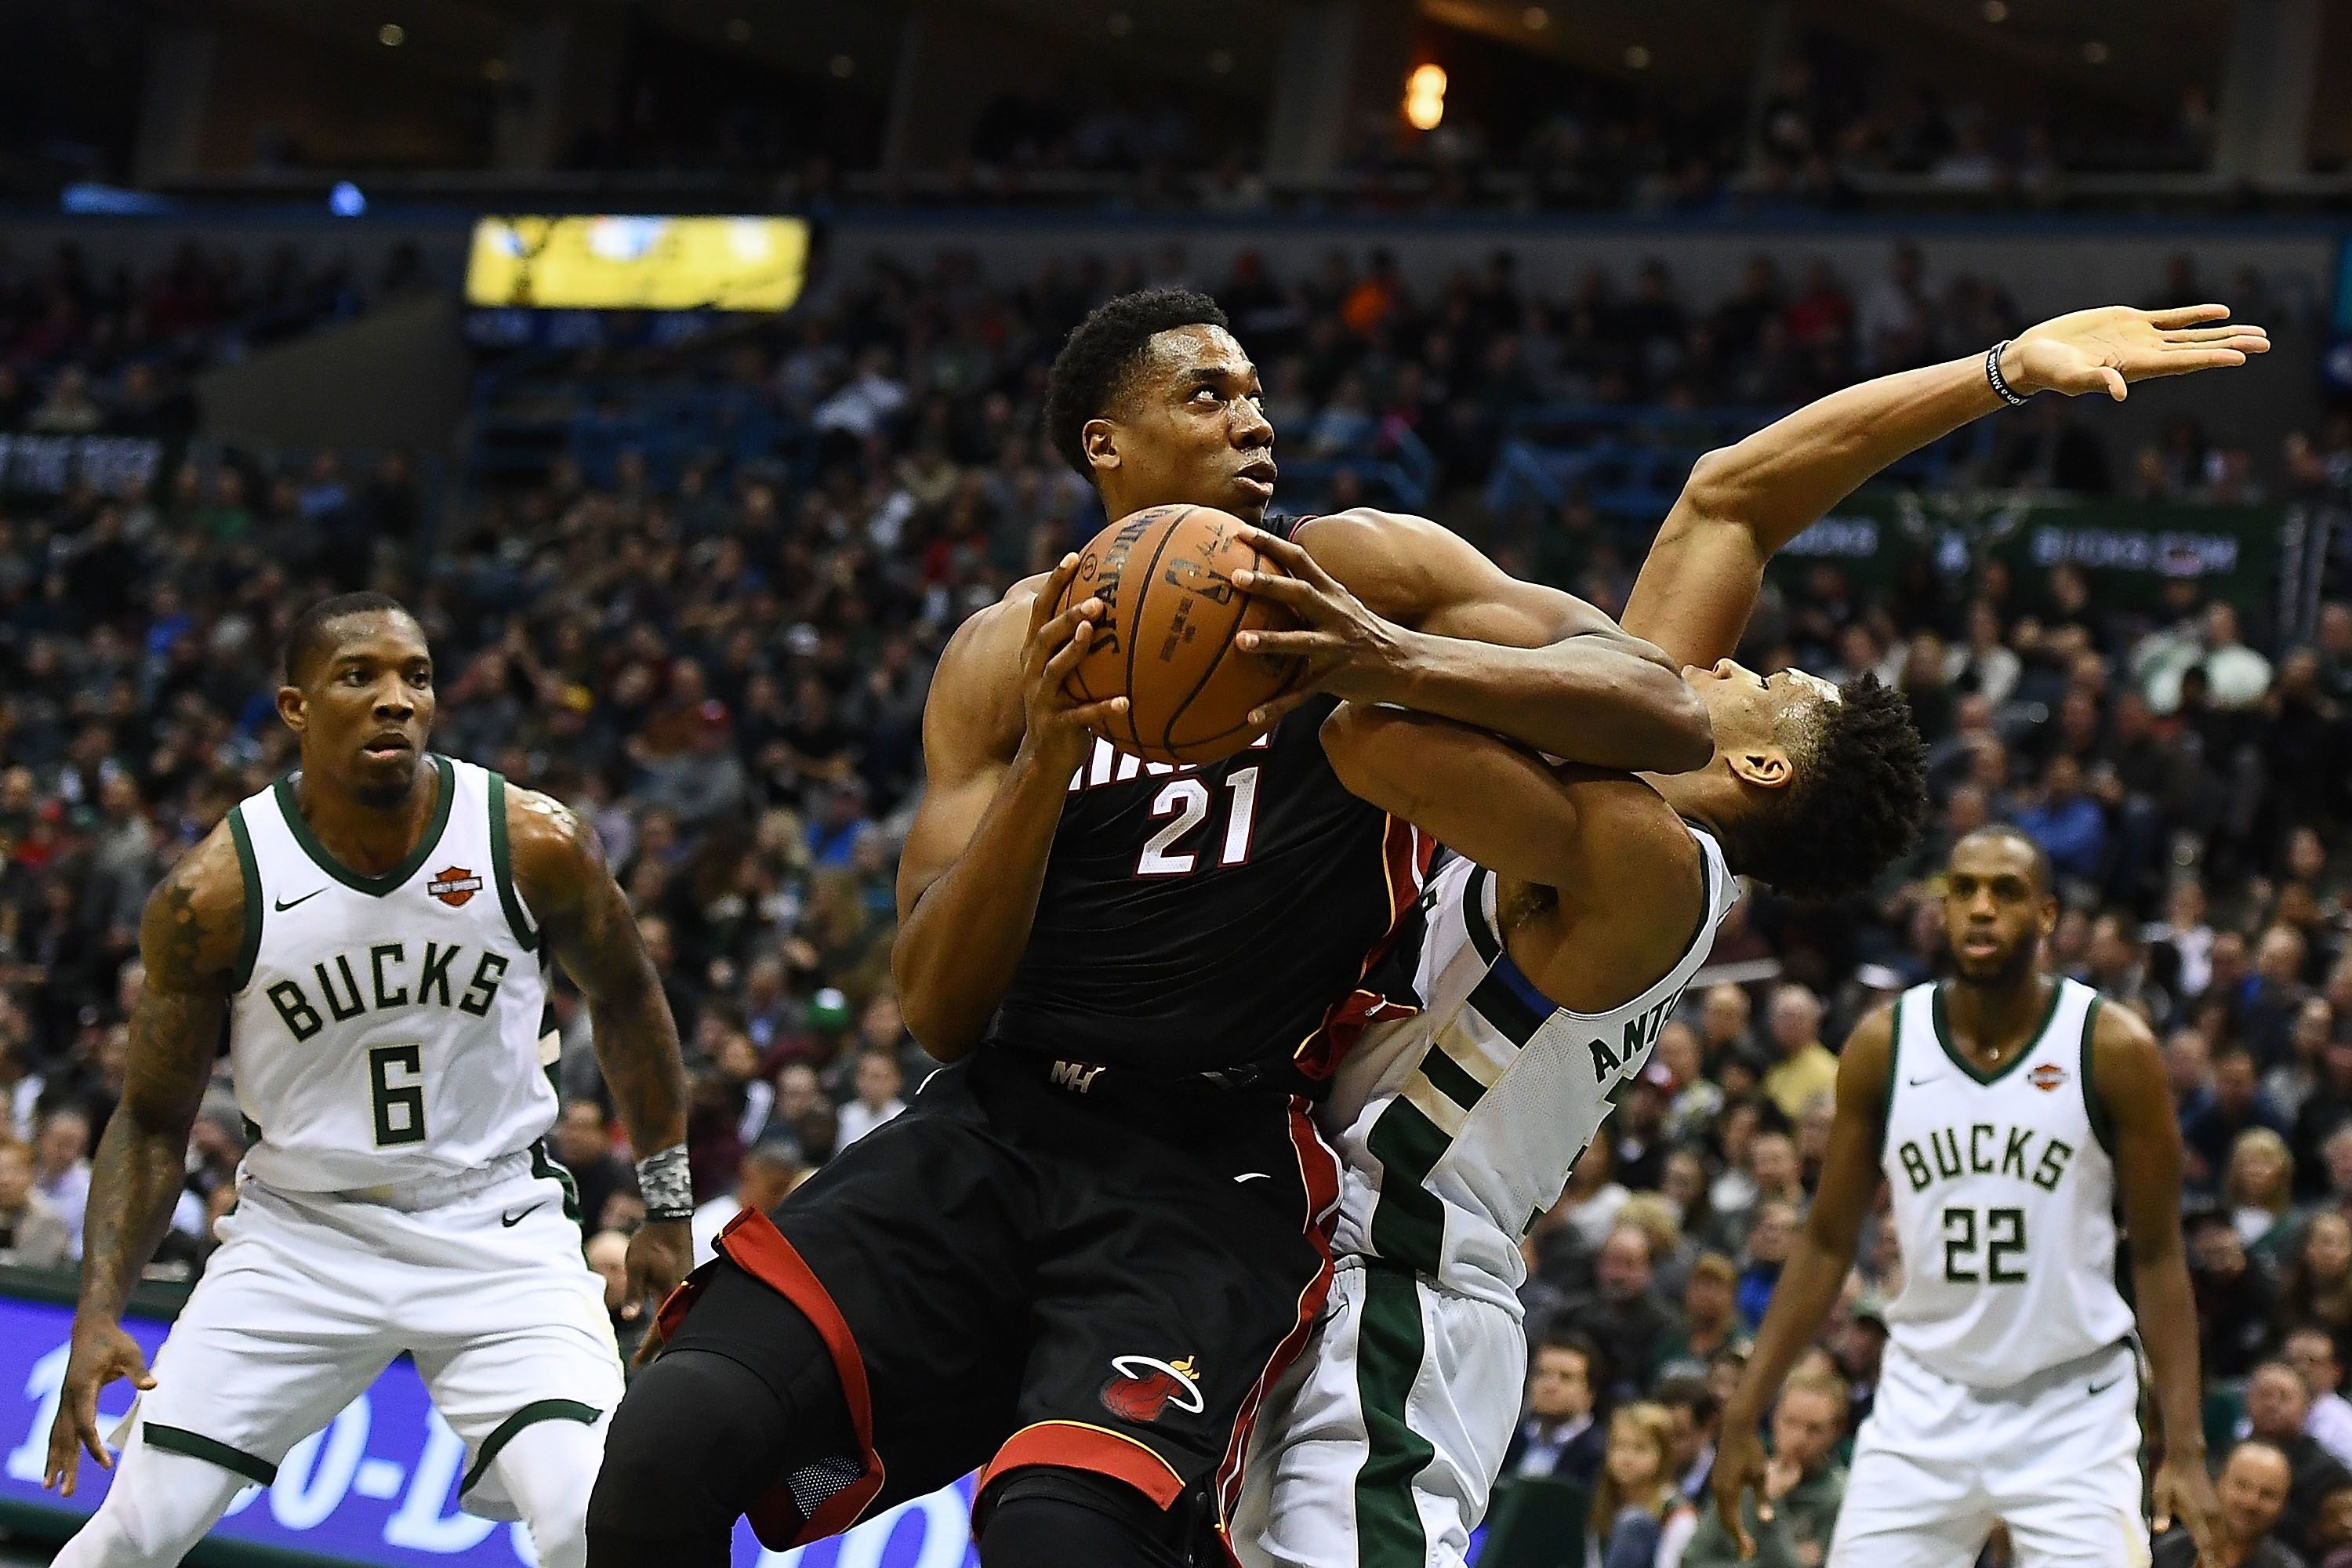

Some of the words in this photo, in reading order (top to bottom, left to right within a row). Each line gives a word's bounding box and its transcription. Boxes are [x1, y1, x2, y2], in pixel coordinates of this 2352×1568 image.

[1987, 352, 2003, 390] Mission
[2006, 394, 2020, 405] On
[1132, 762, 1263, 880] 21
[267, 942, 510, 1043] BUCKS
[368, 1043, 426, 1148] 6
[1899, 1123, 2075, 1195] BUCKS
[1943, 1207, 2030, 1285] 22
